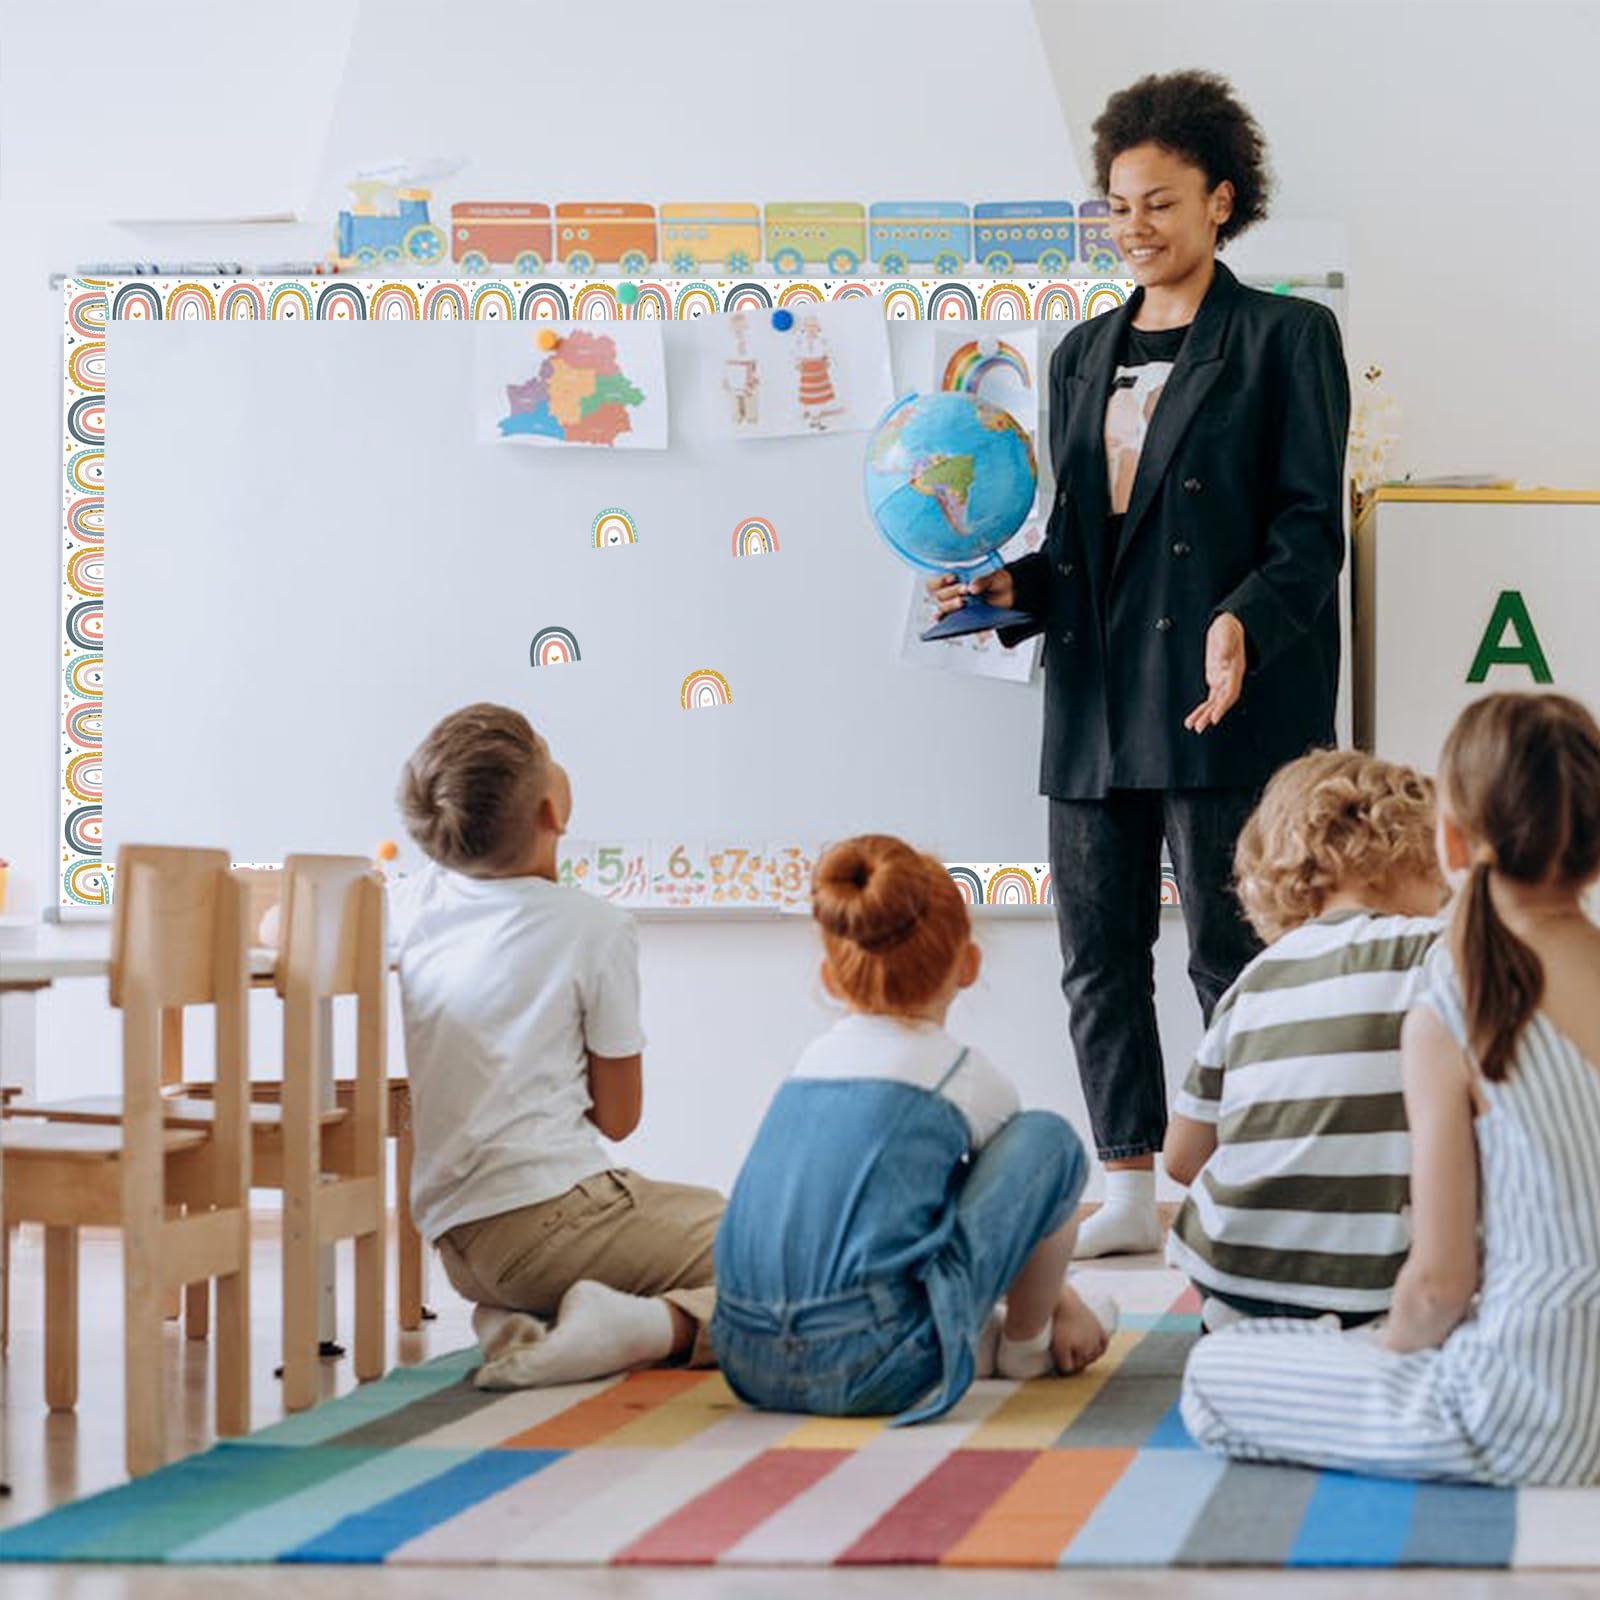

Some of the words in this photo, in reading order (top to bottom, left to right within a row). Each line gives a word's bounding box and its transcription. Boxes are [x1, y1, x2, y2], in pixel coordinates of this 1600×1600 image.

[1465, 590, 1554, 684] A
[597, 848, 624, 885] 5
[668, 844, 691, 879] 6
[724, 848, 749, 879] 7
